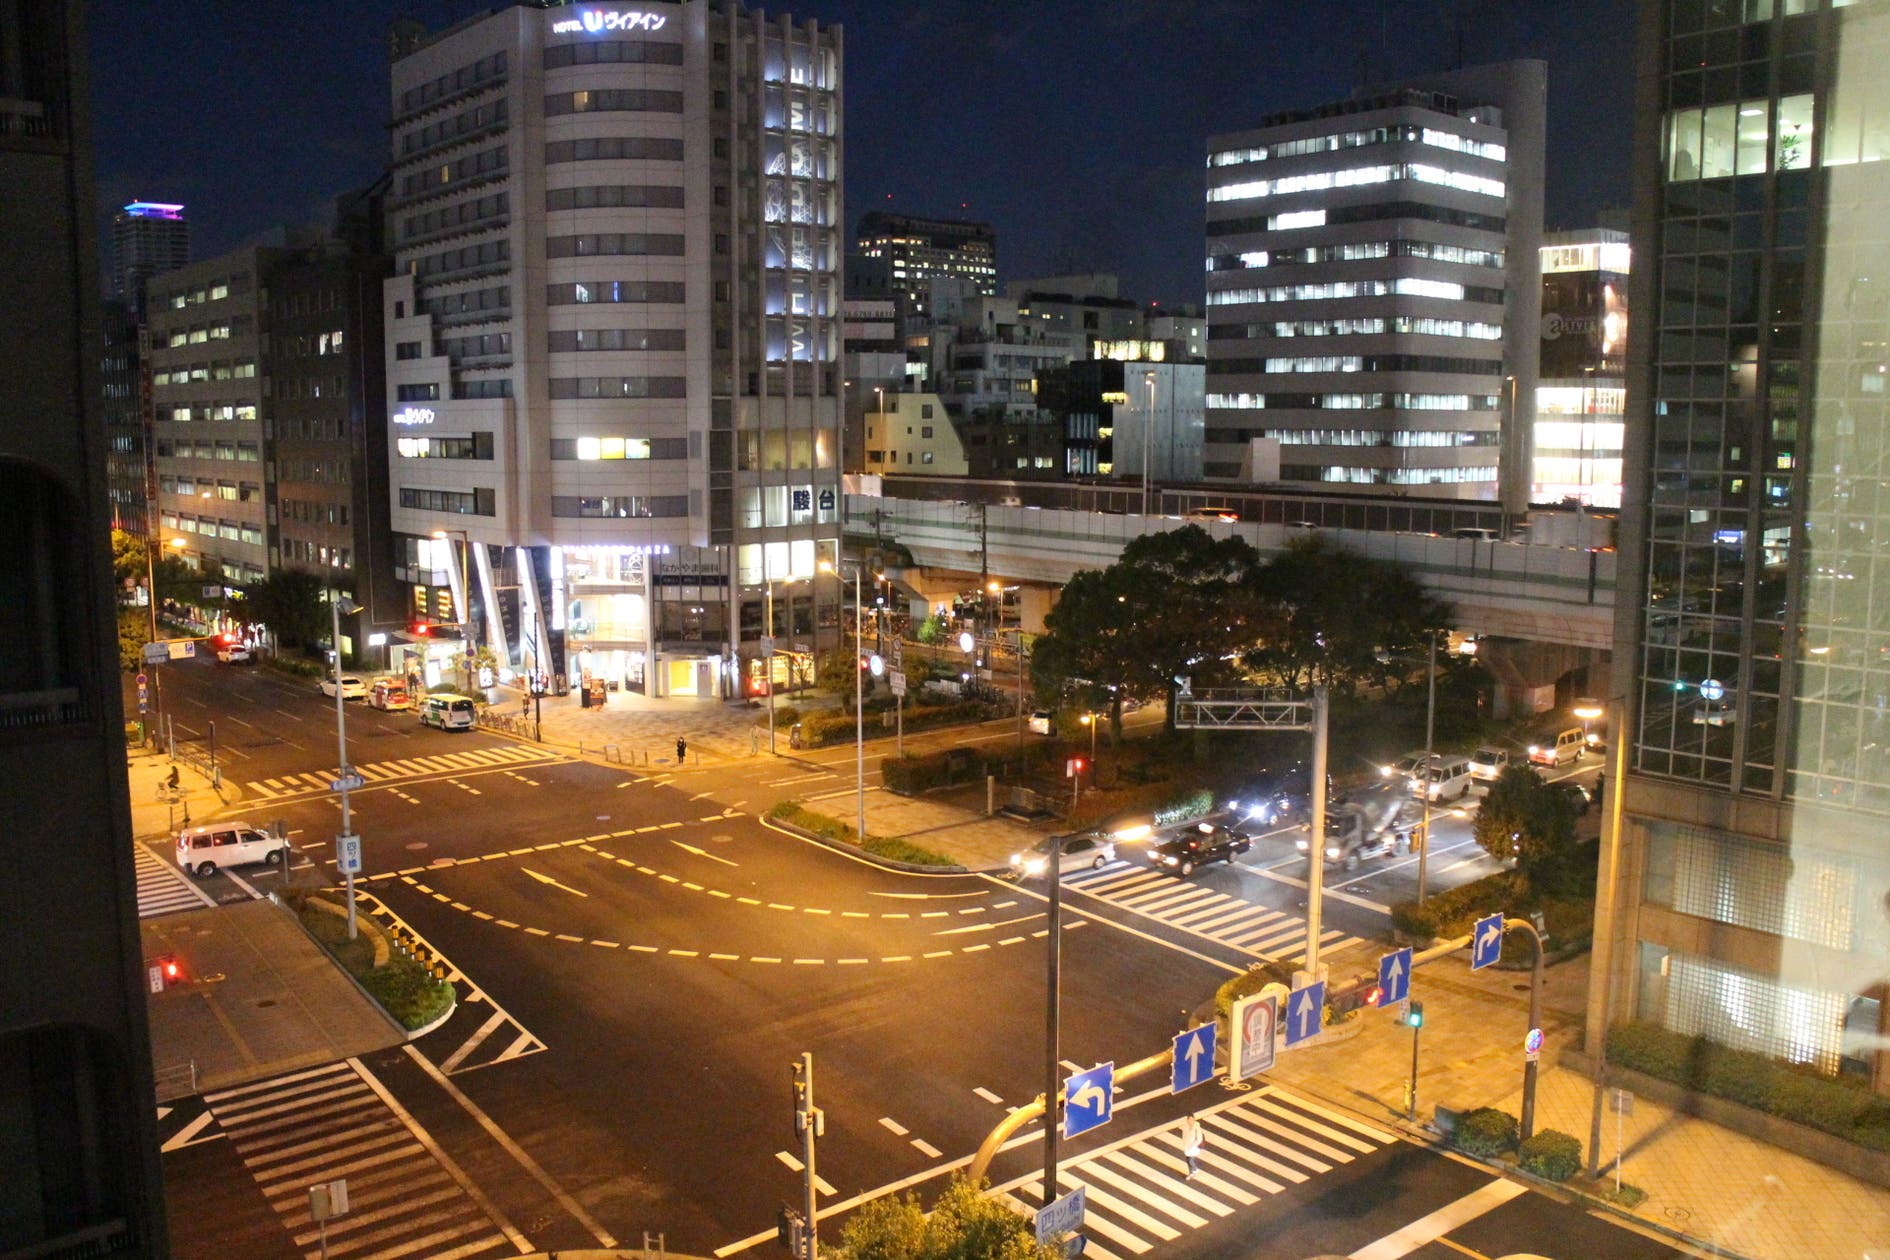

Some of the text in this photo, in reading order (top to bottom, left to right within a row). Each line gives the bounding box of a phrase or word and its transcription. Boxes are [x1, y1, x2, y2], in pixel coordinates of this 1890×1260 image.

[793, 490, 836, 510] 駿台
[1042, 1194, 1080, 1233] 四ツ橋
